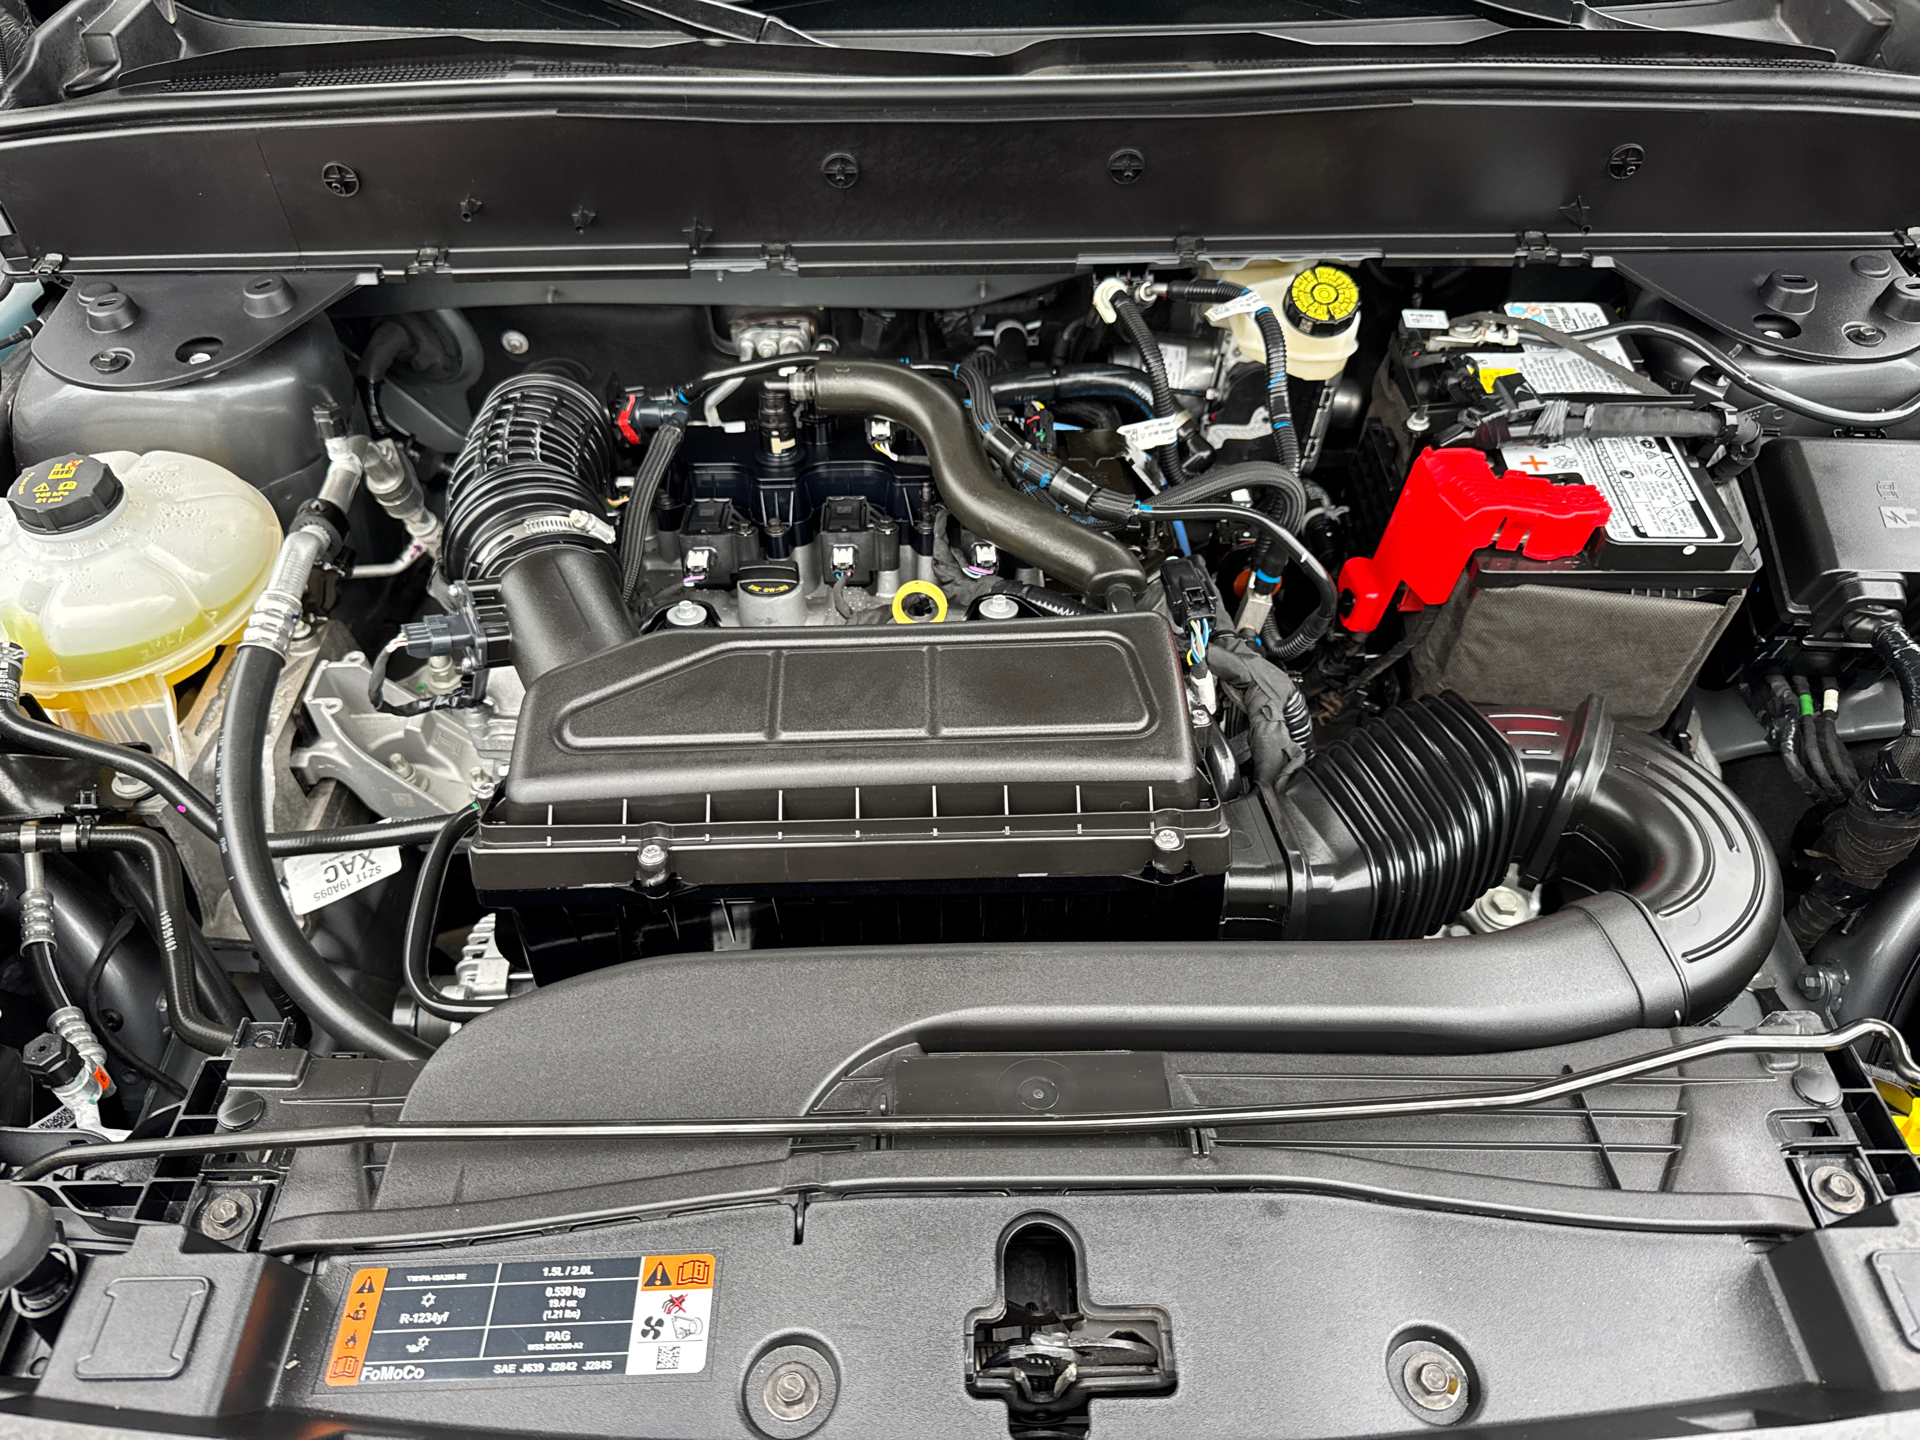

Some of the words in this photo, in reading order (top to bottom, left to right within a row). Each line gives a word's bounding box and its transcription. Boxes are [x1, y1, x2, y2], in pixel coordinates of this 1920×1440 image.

[324, 849, 377, 884] XAC
[313, 878, 352, 902] 19A095
[542, 1266, 564, 1277] 1.5L
[571, 1265, 594, 1276] 2.0L
[545, 1286, 572, 1298] 0.550
[572, 1285, 587, 1299] kg
[566, 1300, 578, 1308] oz
[399, 1311, 450, 1325] R-1234yf
[544, 1331, 571, 1342] PAG
[360, 1365, 425, 1381] FoMoCo
[493, 1364, 517, 1374] SAE
[519, 1363, 545, 1374] J639
[582, 1360, 613, 1371] J2845
